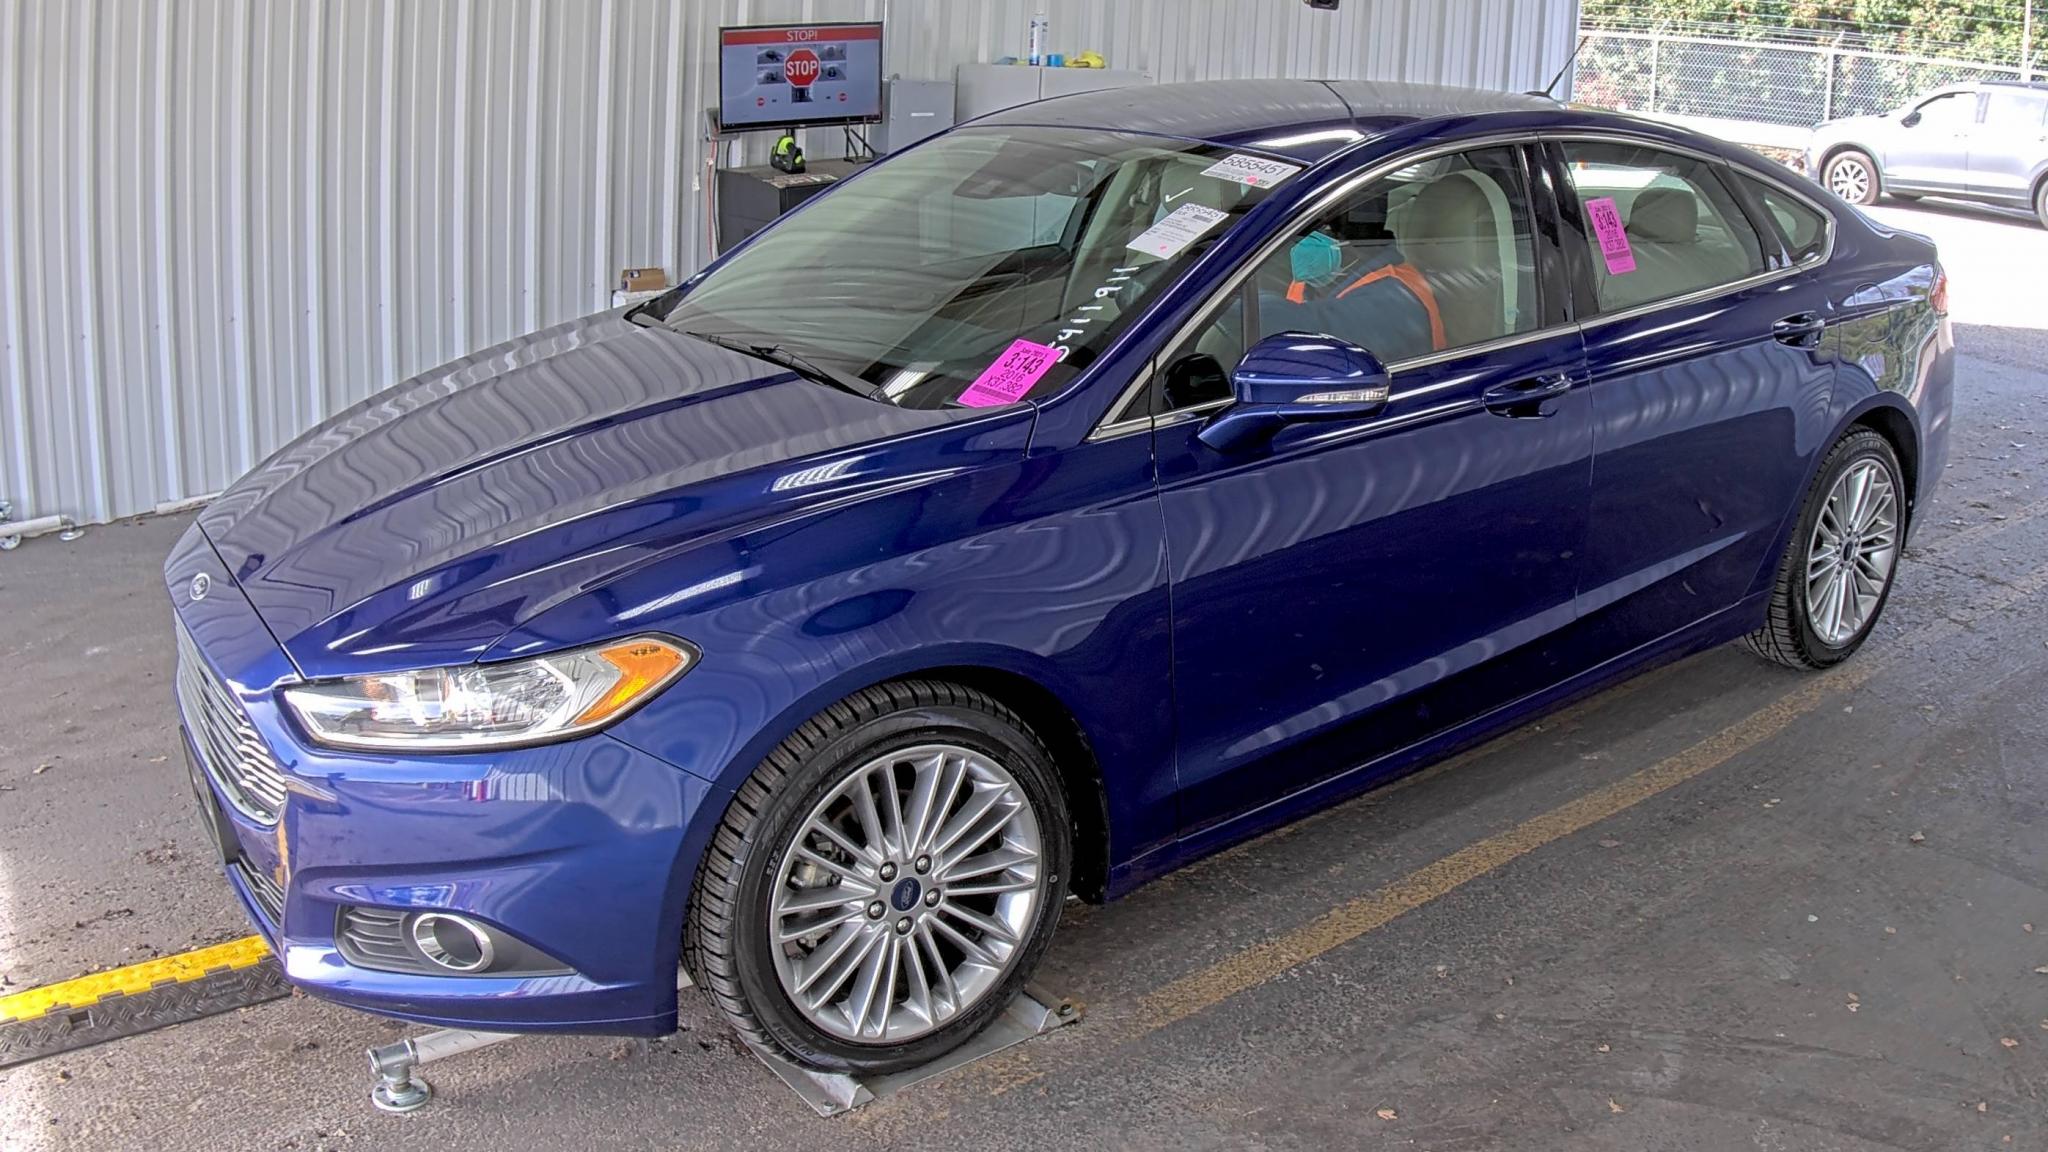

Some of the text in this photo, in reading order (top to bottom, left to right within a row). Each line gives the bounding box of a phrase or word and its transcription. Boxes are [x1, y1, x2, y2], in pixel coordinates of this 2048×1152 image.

[786, 30, 818, 42] STOP!
[786, 63, 818, 76] STOP
[1222, 156, 1289, 176] 5855451
[1003, 352, 1044, 374] 3:143
[1001, 369, 1026, 383] 2016
